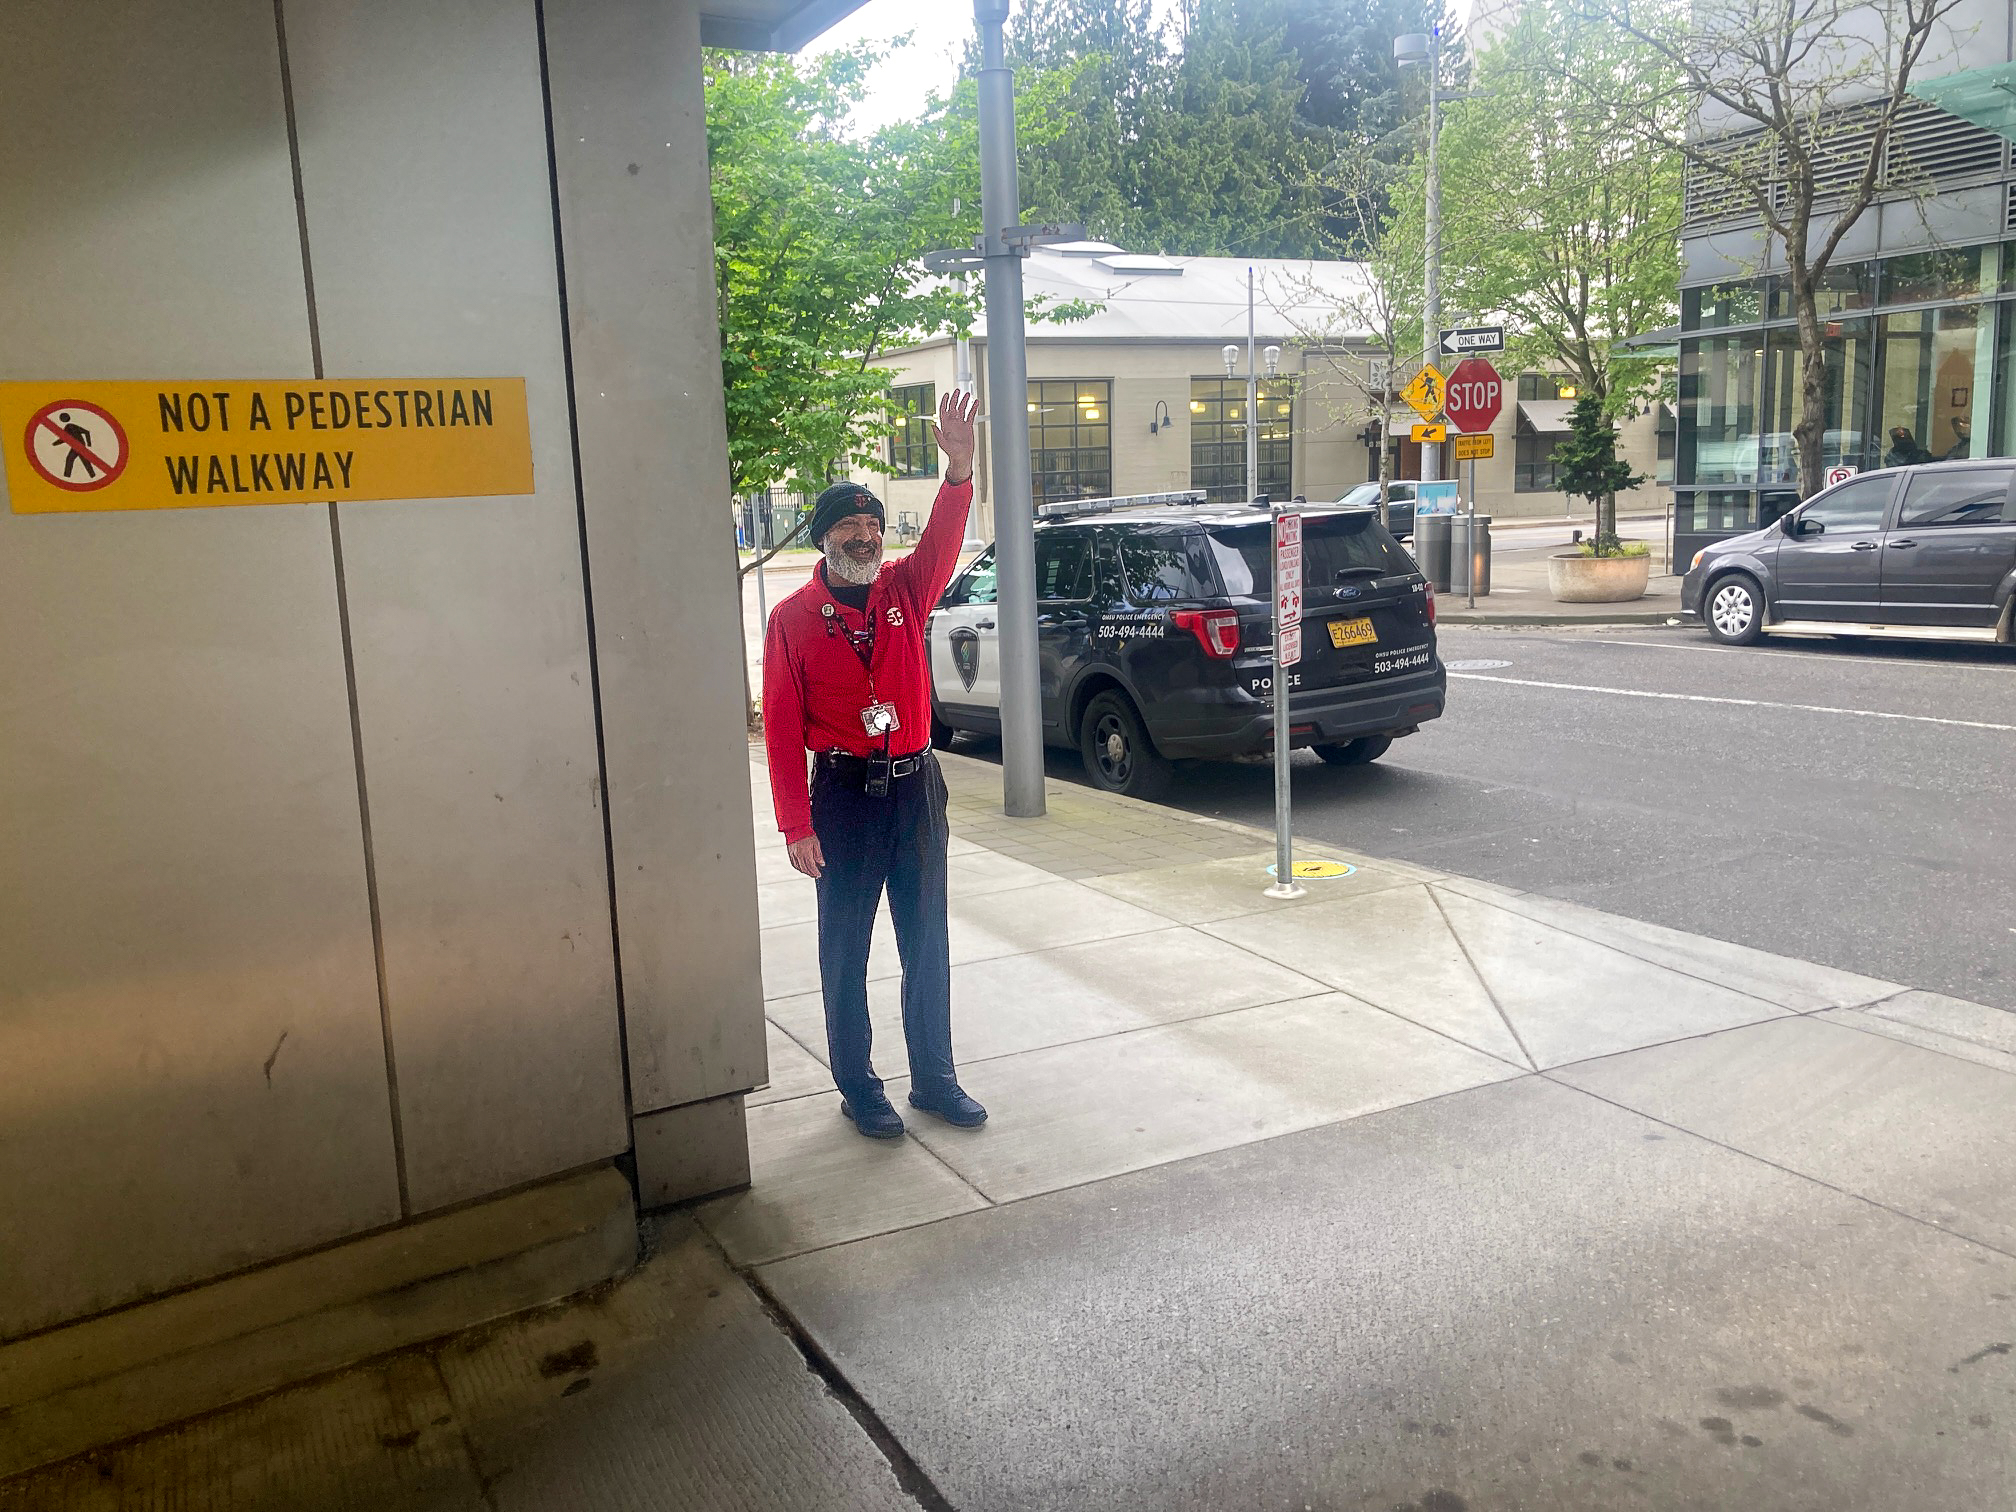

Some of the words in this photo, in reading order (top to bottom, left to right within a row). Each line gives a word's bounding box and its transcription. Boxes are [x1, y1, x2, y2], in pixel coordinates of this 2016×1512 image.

[1458, 336, 1476, 346] ONE
[1478, 333, 1497, 345] WAY
[1449, 381, 1499, 412] STOP
[158, 392, 231, 432] NOT
[249, 392, 270, 431] A
[286, 389, 494, 431] PEDESTRIAN
[165, 451, 354, 494] WALKWAY
[1098, 625, 1165, 639] 503-494-4444
[1332, 623, 1373, 641] E266469
[1390, 648, 1406, 656] POLICE
[1406, 643, 1429, 653] EMERGENCY
[1374, 652, 1430, 674] 503-494-4444
[1251, 674, 1301, 690] POCE
